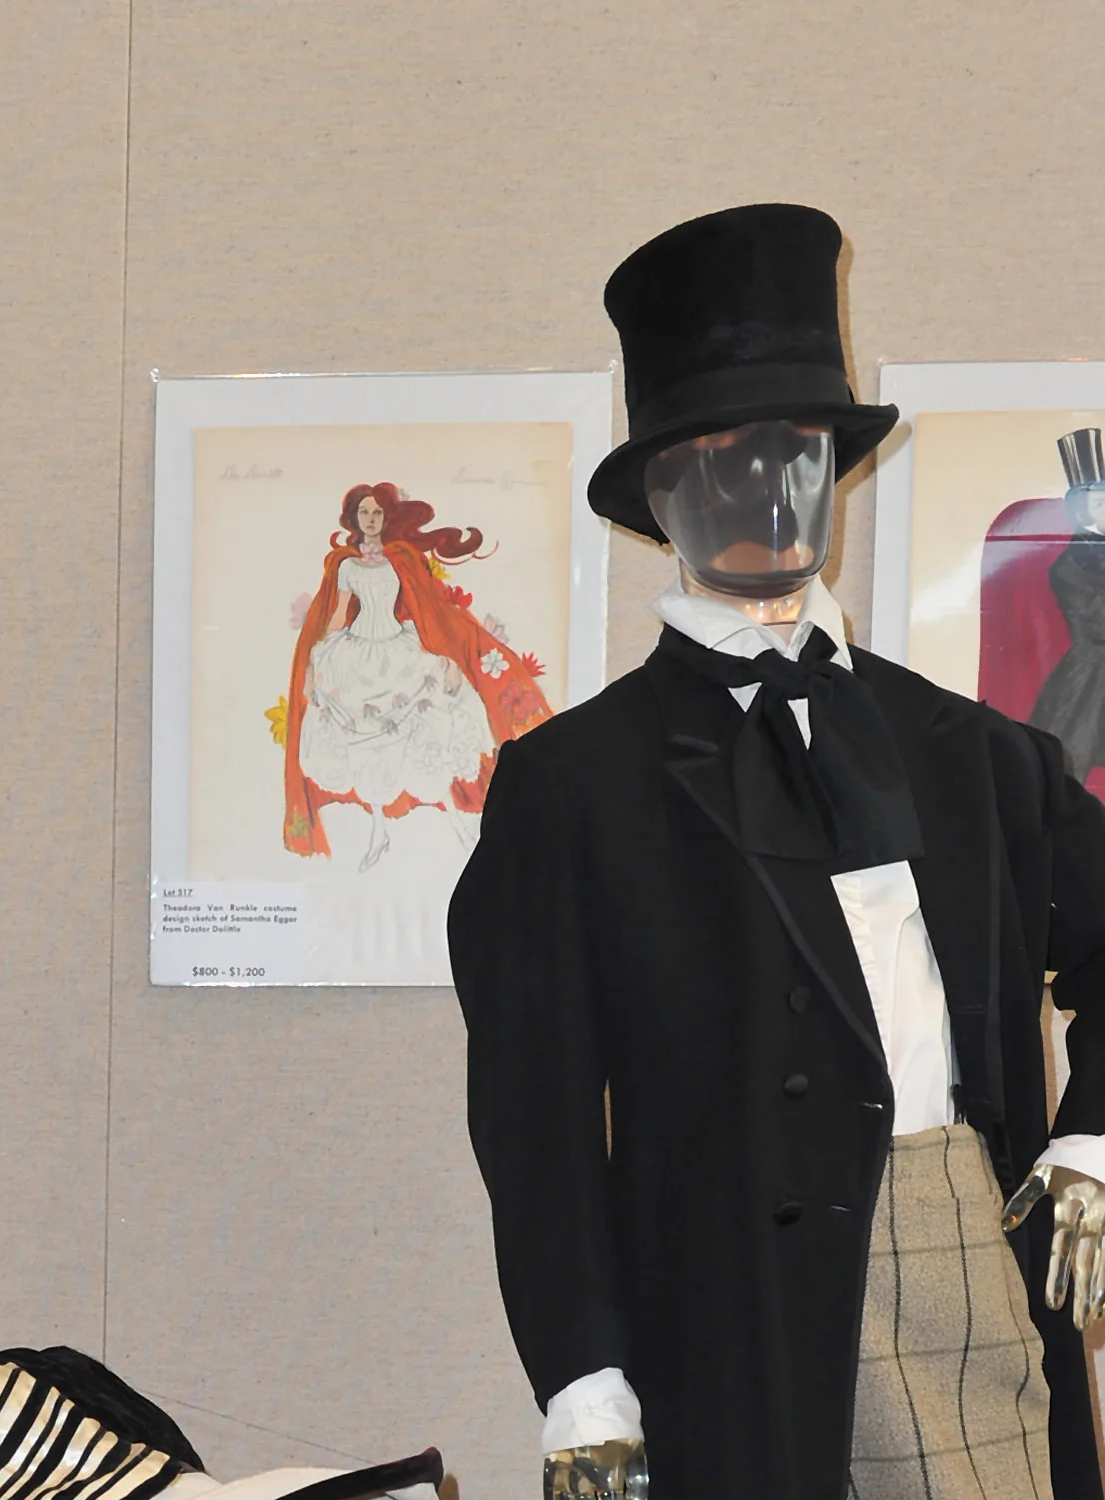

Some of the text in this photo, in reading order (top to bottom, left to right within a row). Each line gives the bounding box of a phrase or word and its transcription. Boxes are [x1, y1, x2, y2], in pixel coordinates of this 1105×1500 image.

[163, 889, 175, 897] Lot
[207, 904, 223, 912] Van
[163, 915, 190, 923] design
[192, 966, 219, 977] $800
[229, 966, 266, 978] $1,200
